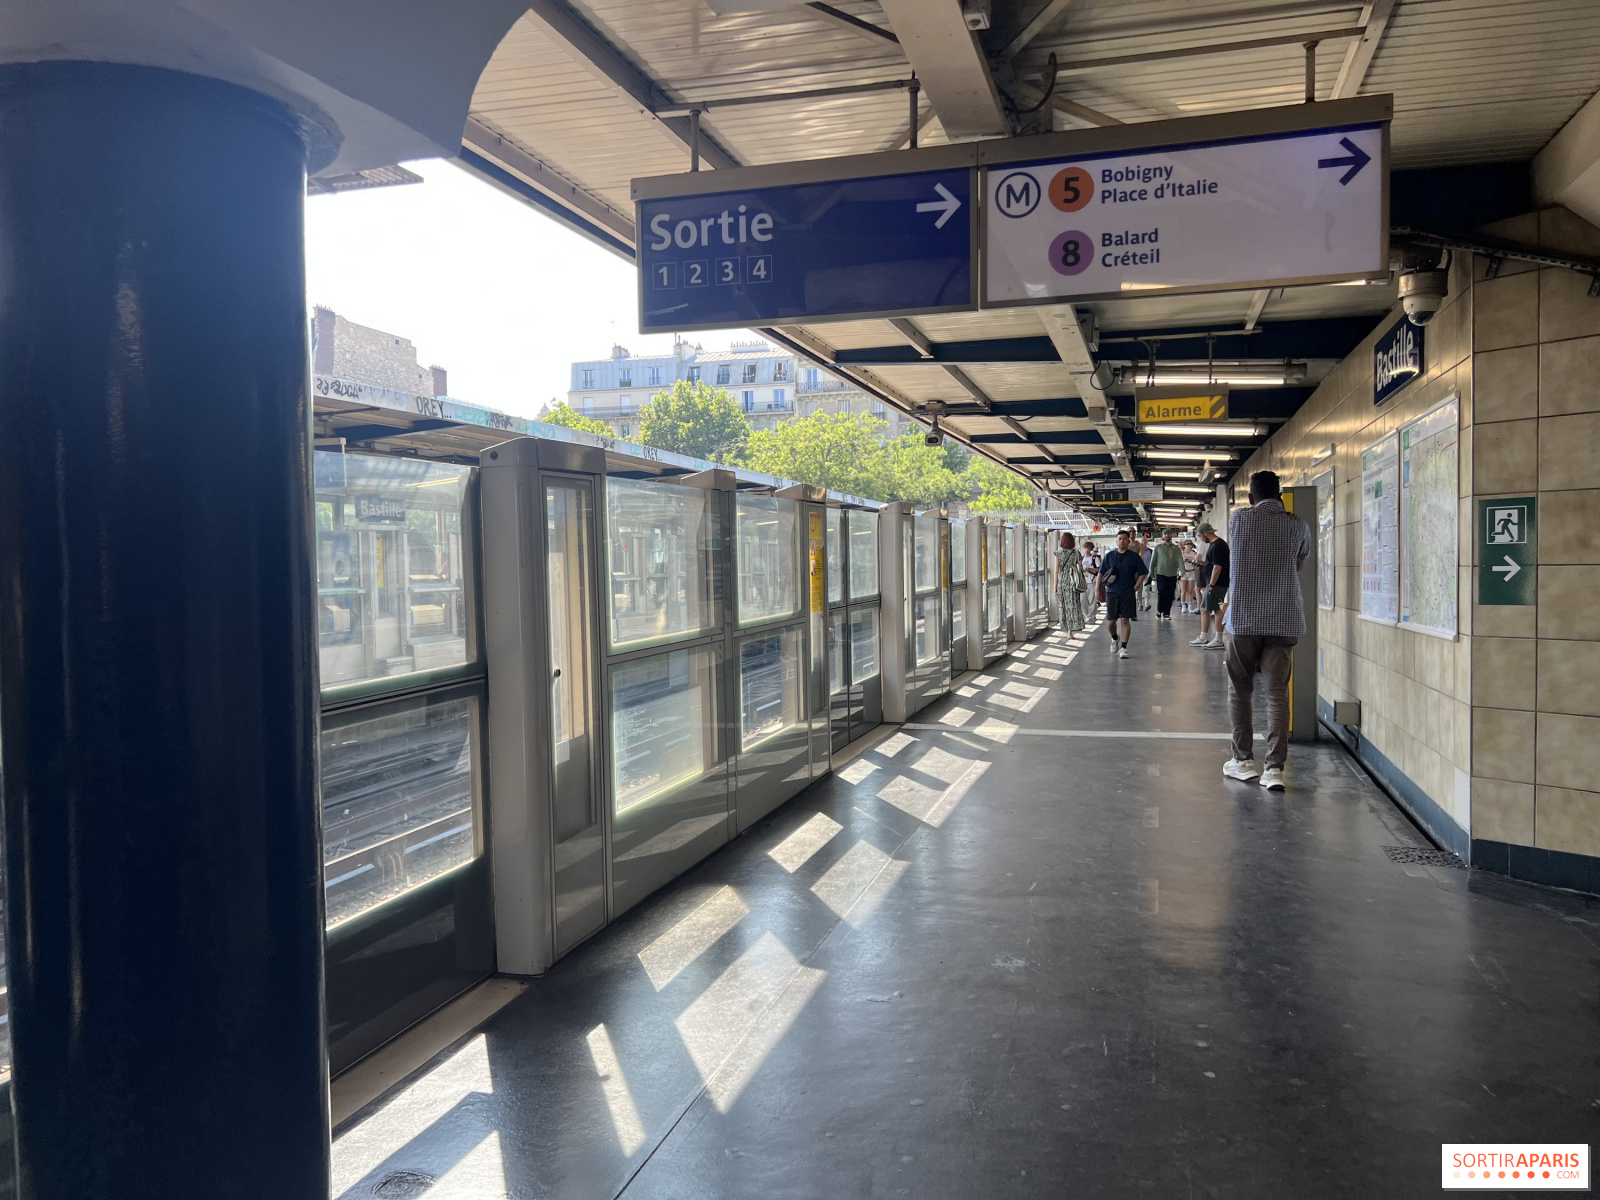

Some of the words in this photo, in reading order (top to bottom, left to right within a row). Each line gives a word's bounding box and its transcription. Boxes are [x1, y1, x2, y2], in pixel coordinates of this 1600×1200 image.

[1102, 164, 1173, 184] Bobigny
[1006, 183, 1030, 208] M
[1063, 176, 1081, 204] 5
[1101, 186, 1149, 205] Place
[1153, 178, 1218, 200] d'Italie
[650, 204, 774, 251] Sortie
[1101, 228, 1159, 247] Balard
[1061, 240, 1080, 267] 8
[1101, 248, 1160, 268] Créteil
[658, 266, 669, 286] 1
[690, 263, 702, 284] 2
[721, 261, 735, 282] 3
[752, 258, 767, 280] 4
[1376, 324, 1414, 392] Bastille
[1144, 402, 1202, 419] Alarme
[360, 499, 403, 518] Bastille
